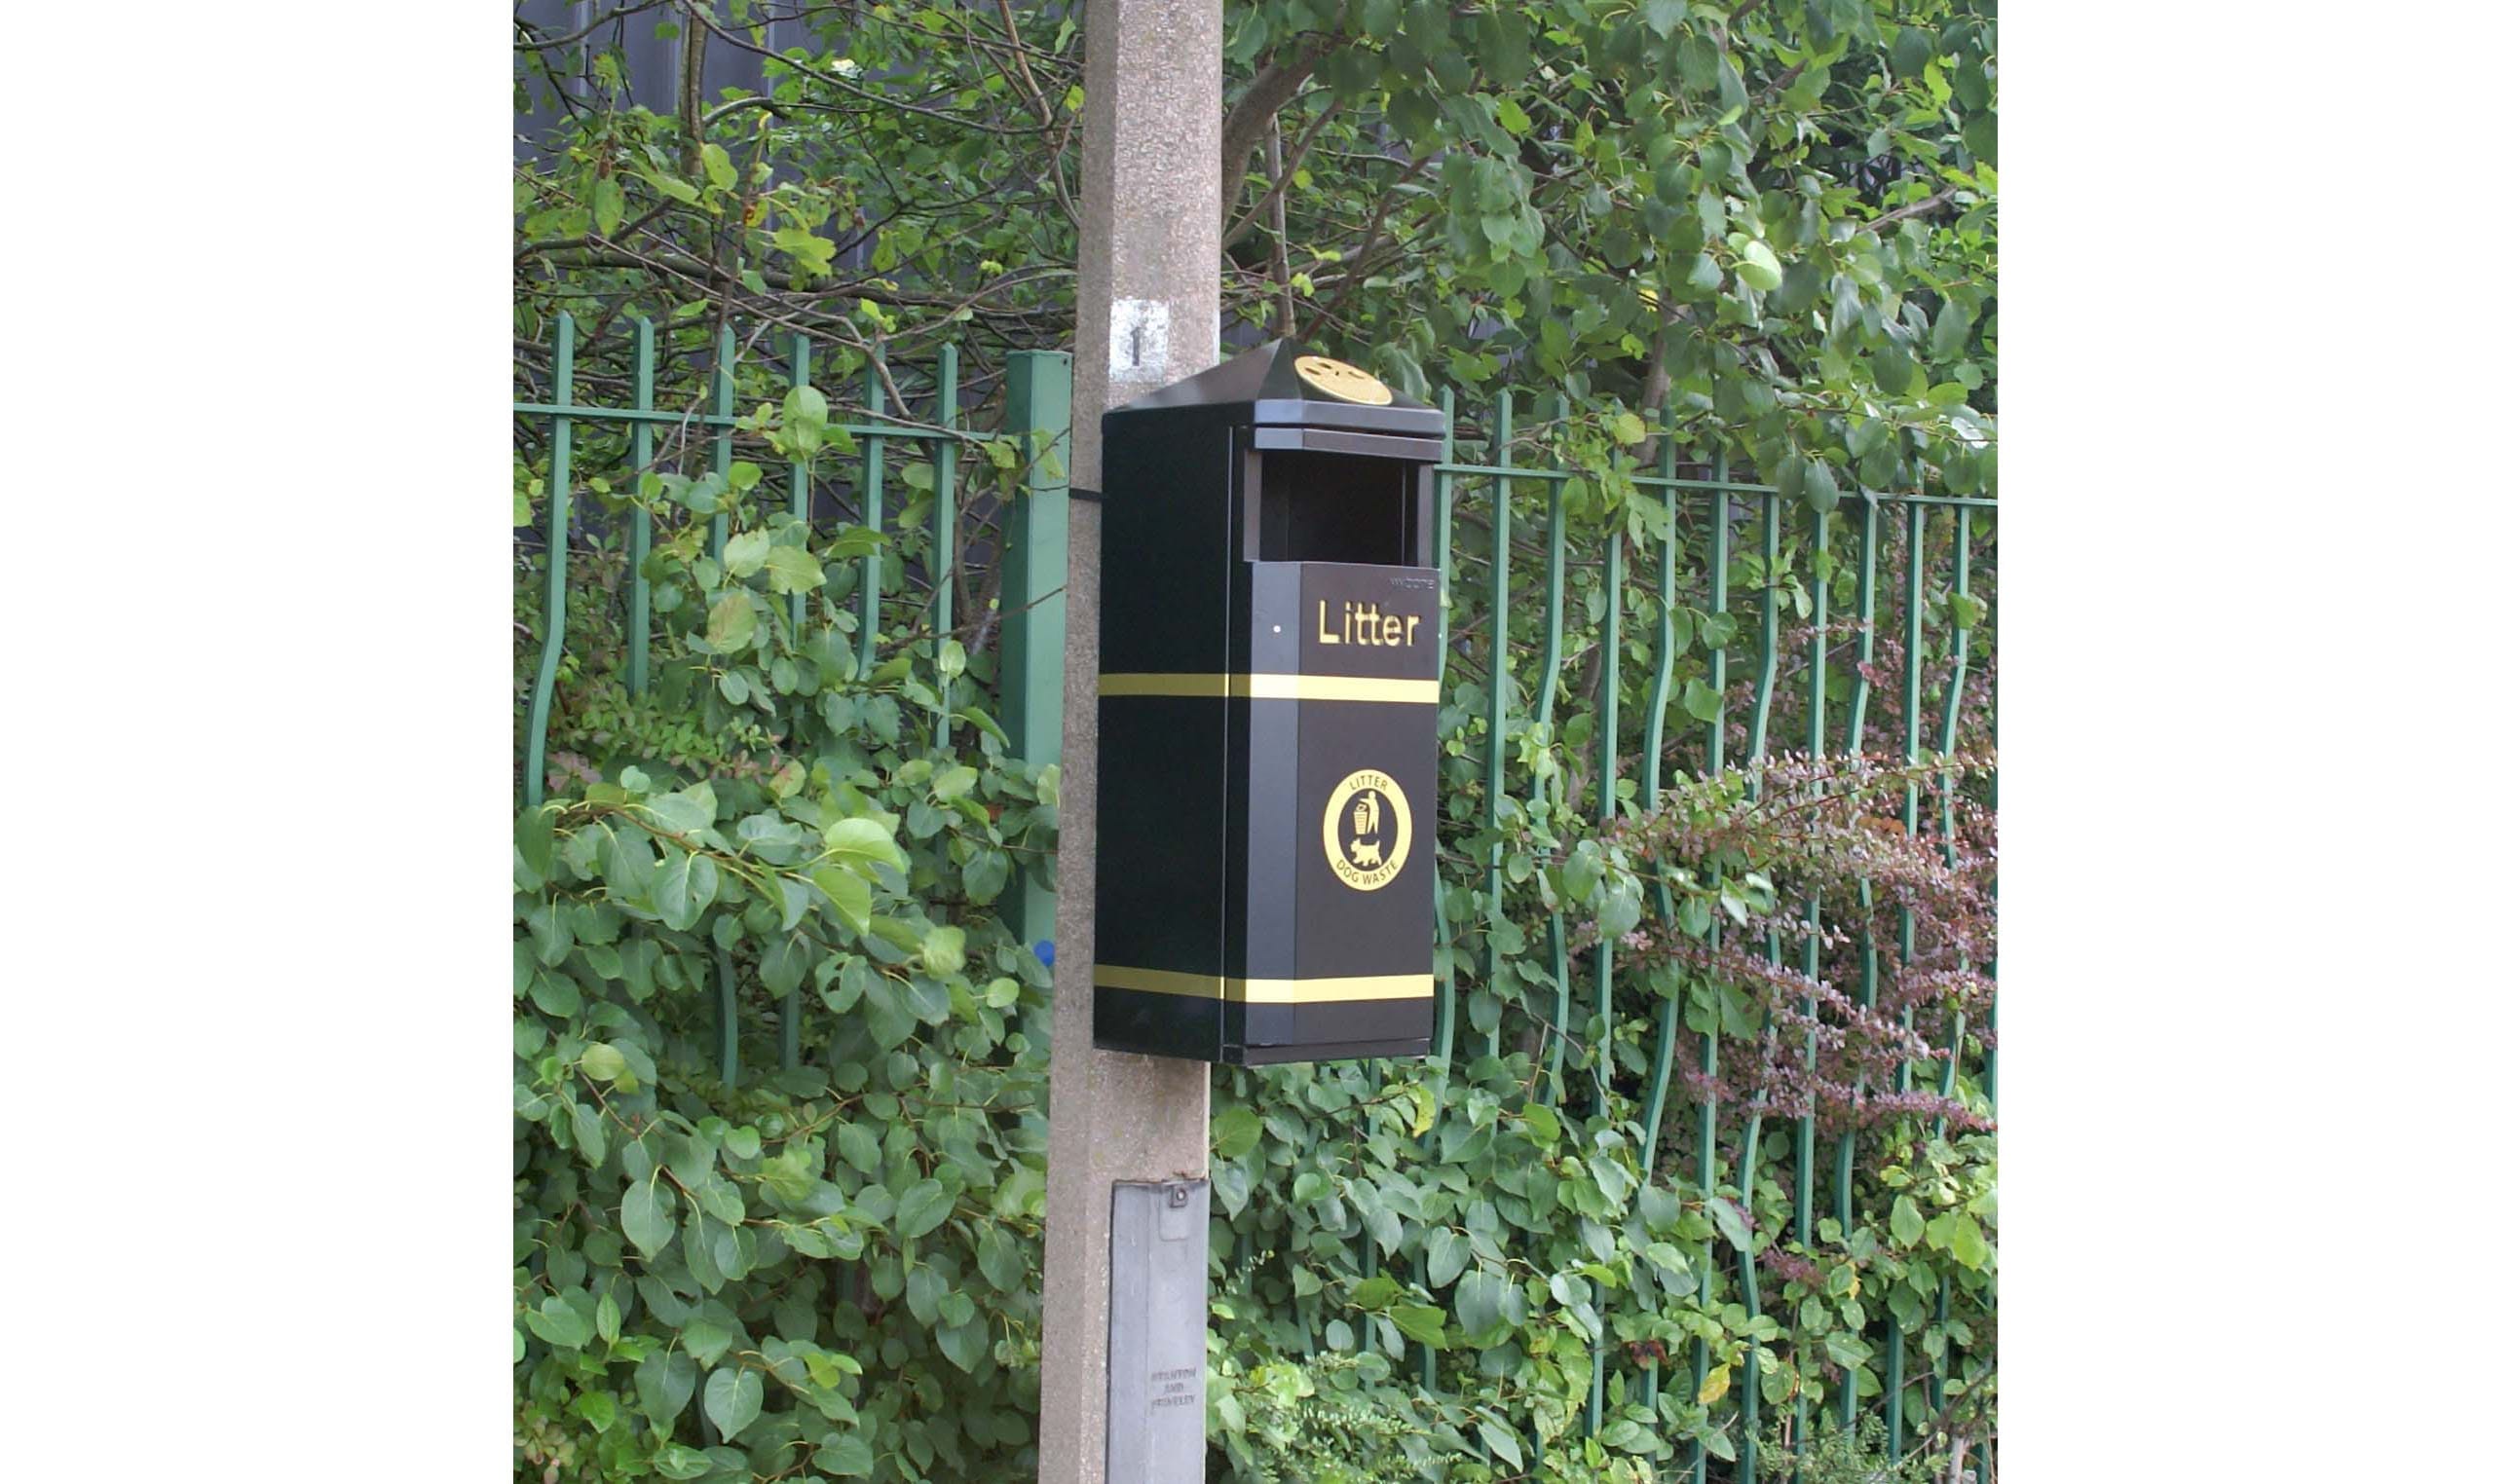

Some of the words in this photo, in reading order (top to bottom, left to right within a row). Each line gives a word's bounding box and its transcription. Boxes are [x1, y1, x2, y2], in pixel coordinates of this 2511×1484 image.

[1320, 599, 1421, 647] Litter
[1349, 775, 1388, 791] LITTER
[1336, 859, 1360, 883] DOG
[1362, 859, 1398, 885] WASTE
